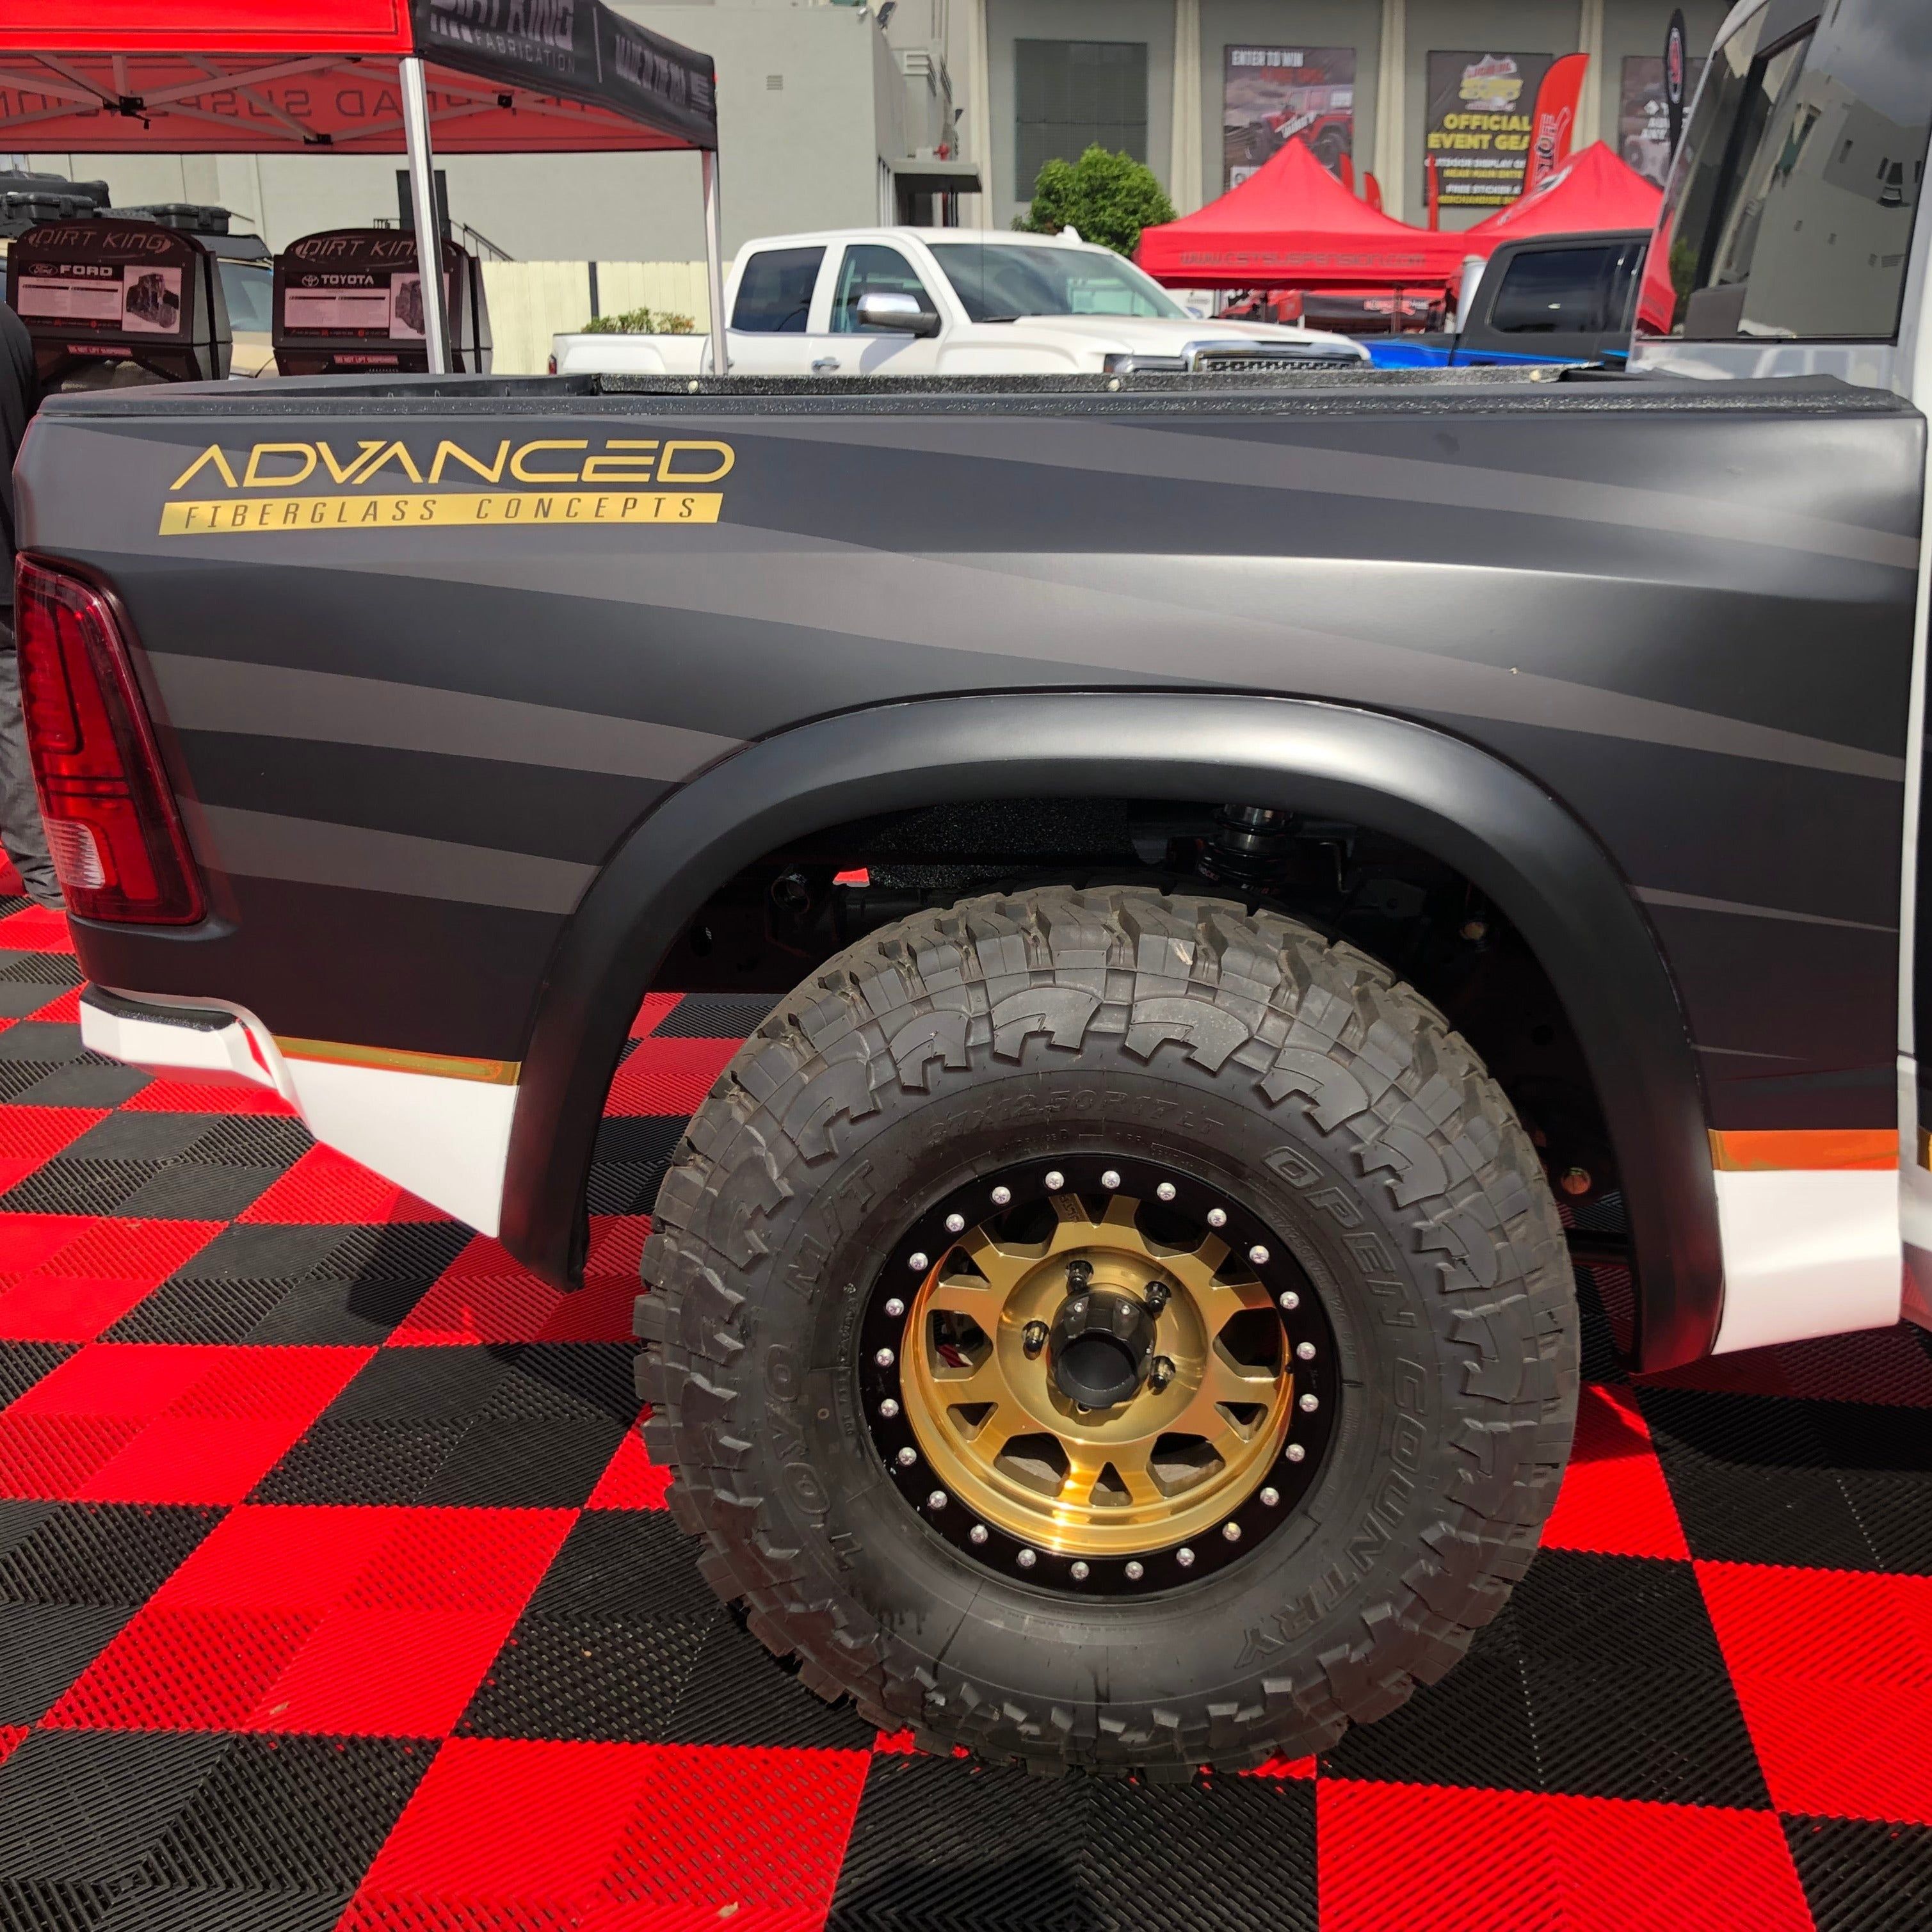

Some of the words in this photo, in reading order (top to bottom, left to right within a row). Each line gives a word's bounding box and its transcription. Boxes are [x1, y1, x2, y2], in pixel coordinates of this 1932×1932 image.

[474, 29, 576, 73] FABRICATION
[1444, 113, 1531, 131] OFFICIAL
[1427, 132, 1492, 149] EVENT
[1494, 134, 1530, 150] GEA
[36, 229, 97, 248] DIRT
[102, 232, 166, 250] KING
[302, 239, 365, 256] DIRT
[370, 240, 418, 257] KIN
[60, 264, 113, 277] FORD
[321, 274, 374, 286] TOYOTA
[170, 440, 736, 490] ADVANCED
[184, 499, 437, 529] FIBERGLASS
[476, 495, 696, 520] CONCEPTS
[1261, 1145, 1418, 1328] OPEN
[762, 1344, 863, 1572] TOYO
[1235, 1357, 1427, 1668] COUNTRY
